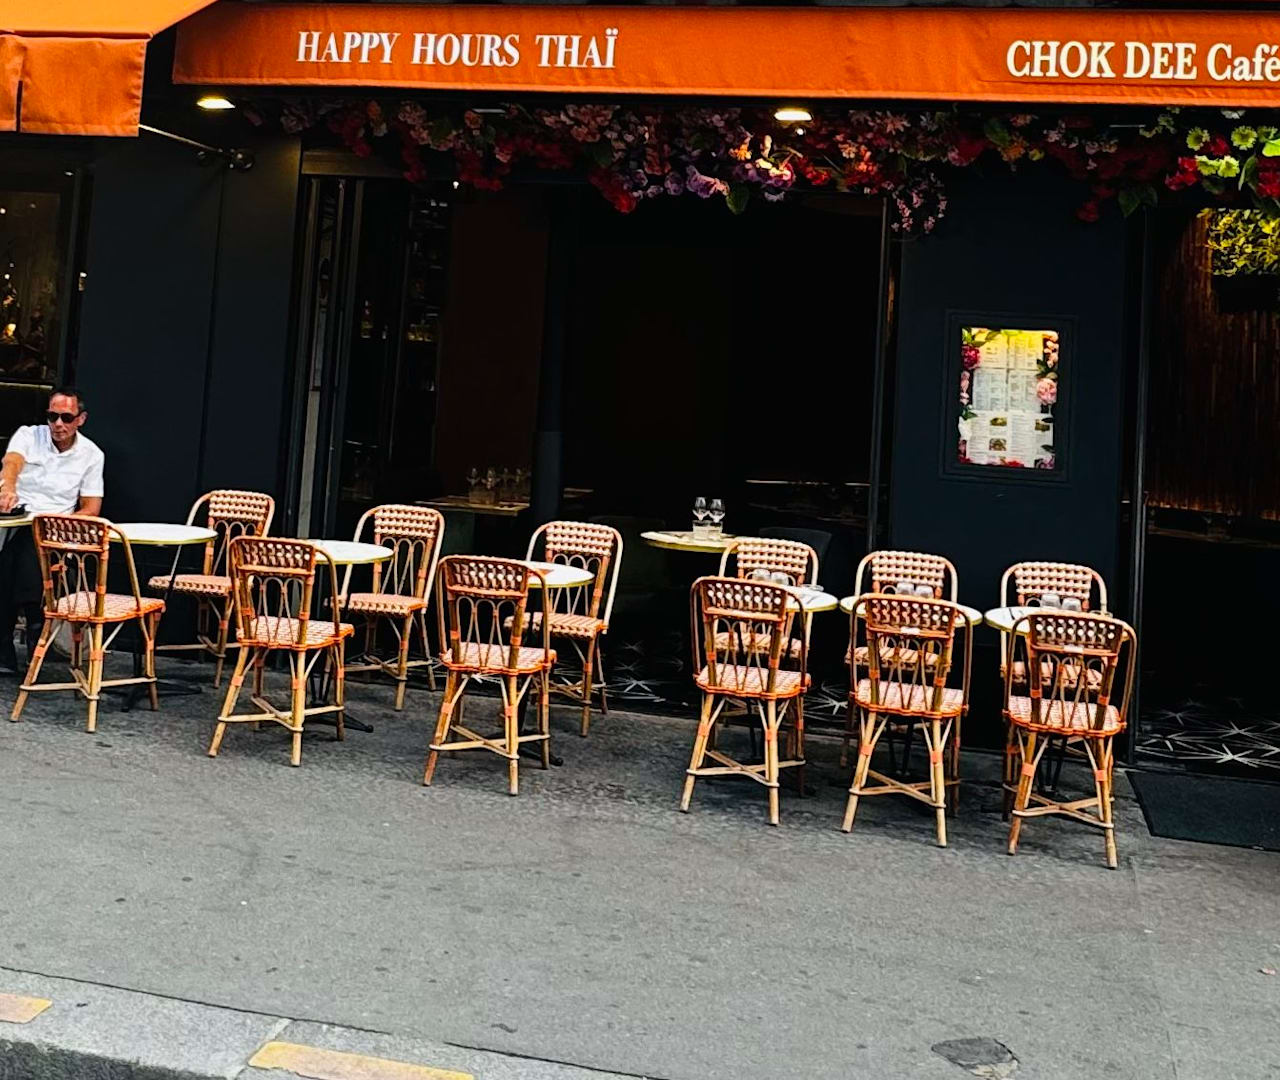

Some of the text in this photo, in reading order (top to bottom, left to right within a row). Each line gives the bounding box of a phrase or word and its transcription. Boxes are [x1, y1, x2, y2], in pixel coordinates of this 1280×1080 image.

[296, 27, 619, 69] HAPPY HOURS THAÏ
[1006, 40, 1116, 78] CHOK
[1123, 40, 1198, 80] DEE
